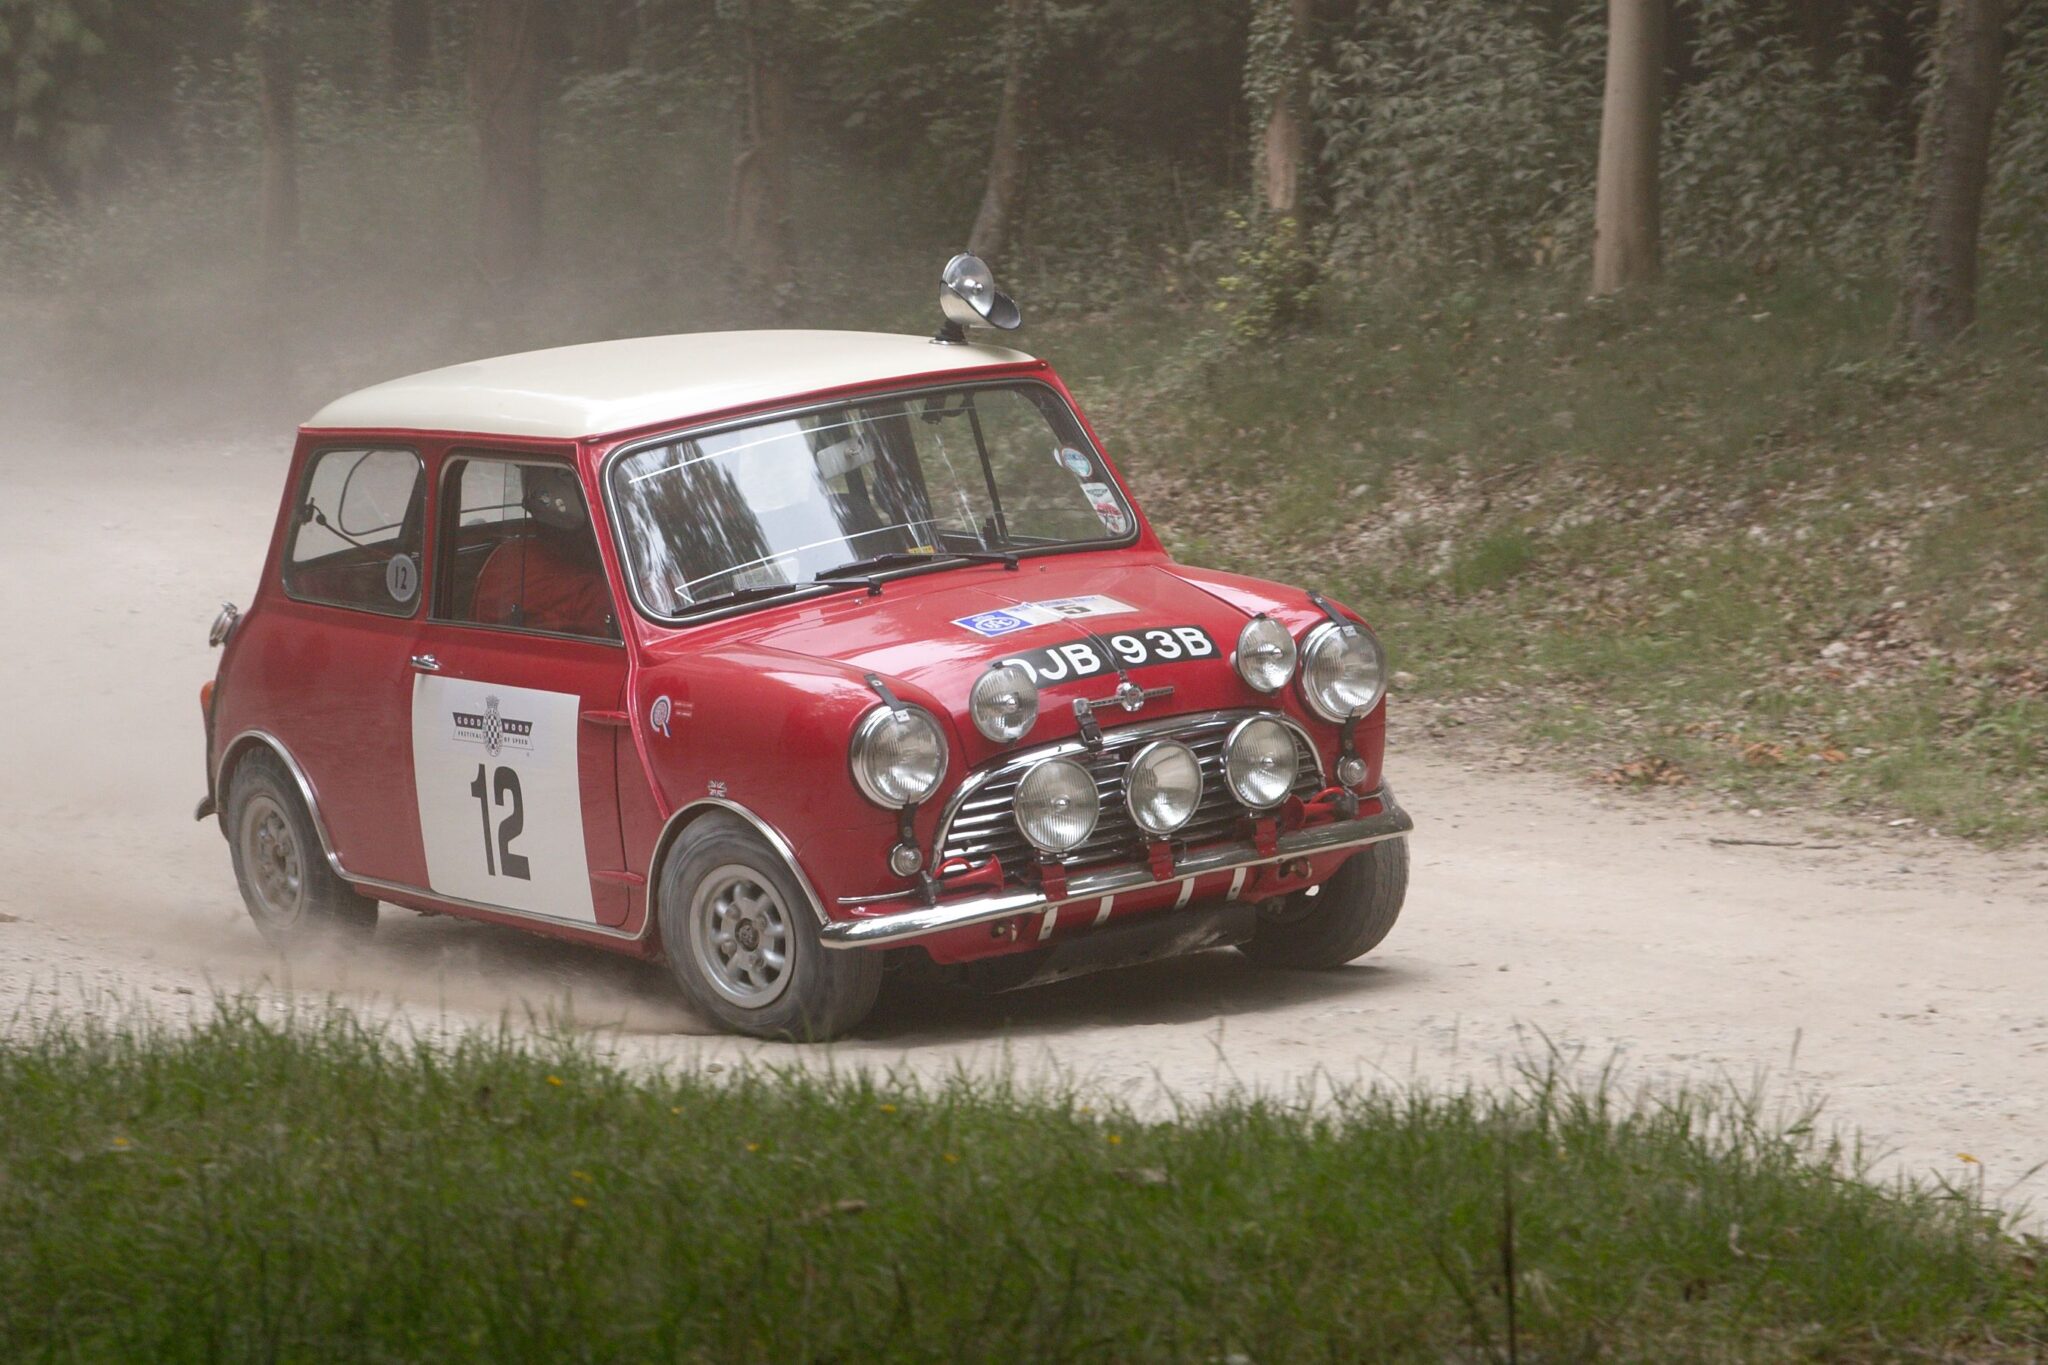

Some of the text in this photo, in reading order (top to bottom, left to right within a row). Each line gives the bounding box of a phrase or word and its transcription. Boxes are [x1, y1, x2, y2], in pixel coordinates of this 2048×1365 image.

[394, 566, 407, 590] 12
[1053, 603, 1092, 615] 5
[1111, 627, 1213, 664] 93B
[457, 717, 529, 733] GOOD WOOD
[470, 763, 531, 881] 12
